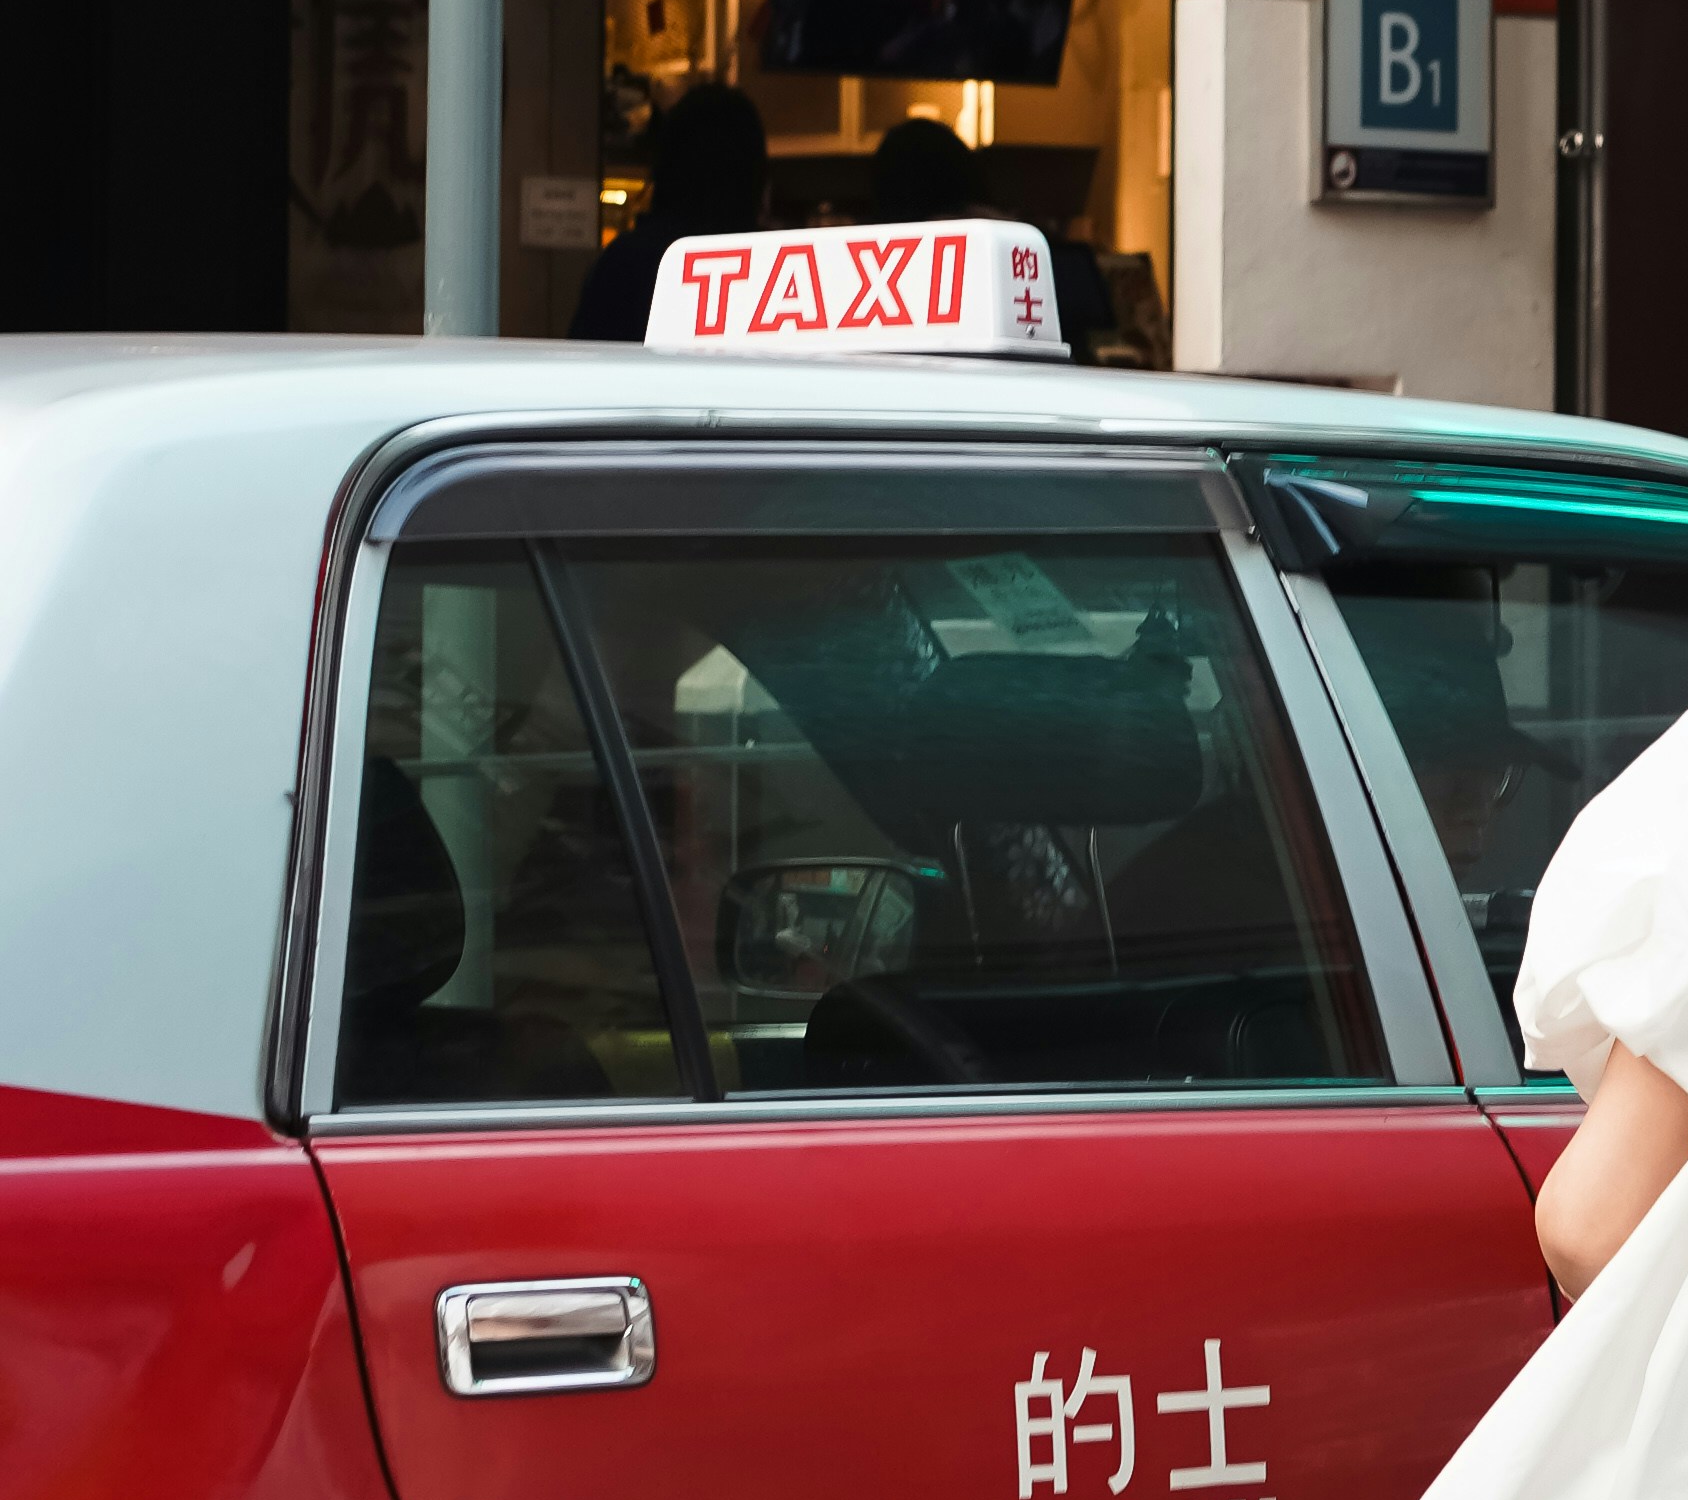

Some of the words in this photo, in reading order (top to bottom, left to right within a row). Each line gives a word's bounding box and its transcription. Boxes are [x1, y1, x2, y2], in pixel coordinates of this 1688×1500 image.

[1378, 11, 1442, 107] B1
[681, 234, 969, 337] TAXI
[1011, 245, 1044, 326] 的士
[1014, 1338, 1271, 1500] 的士
